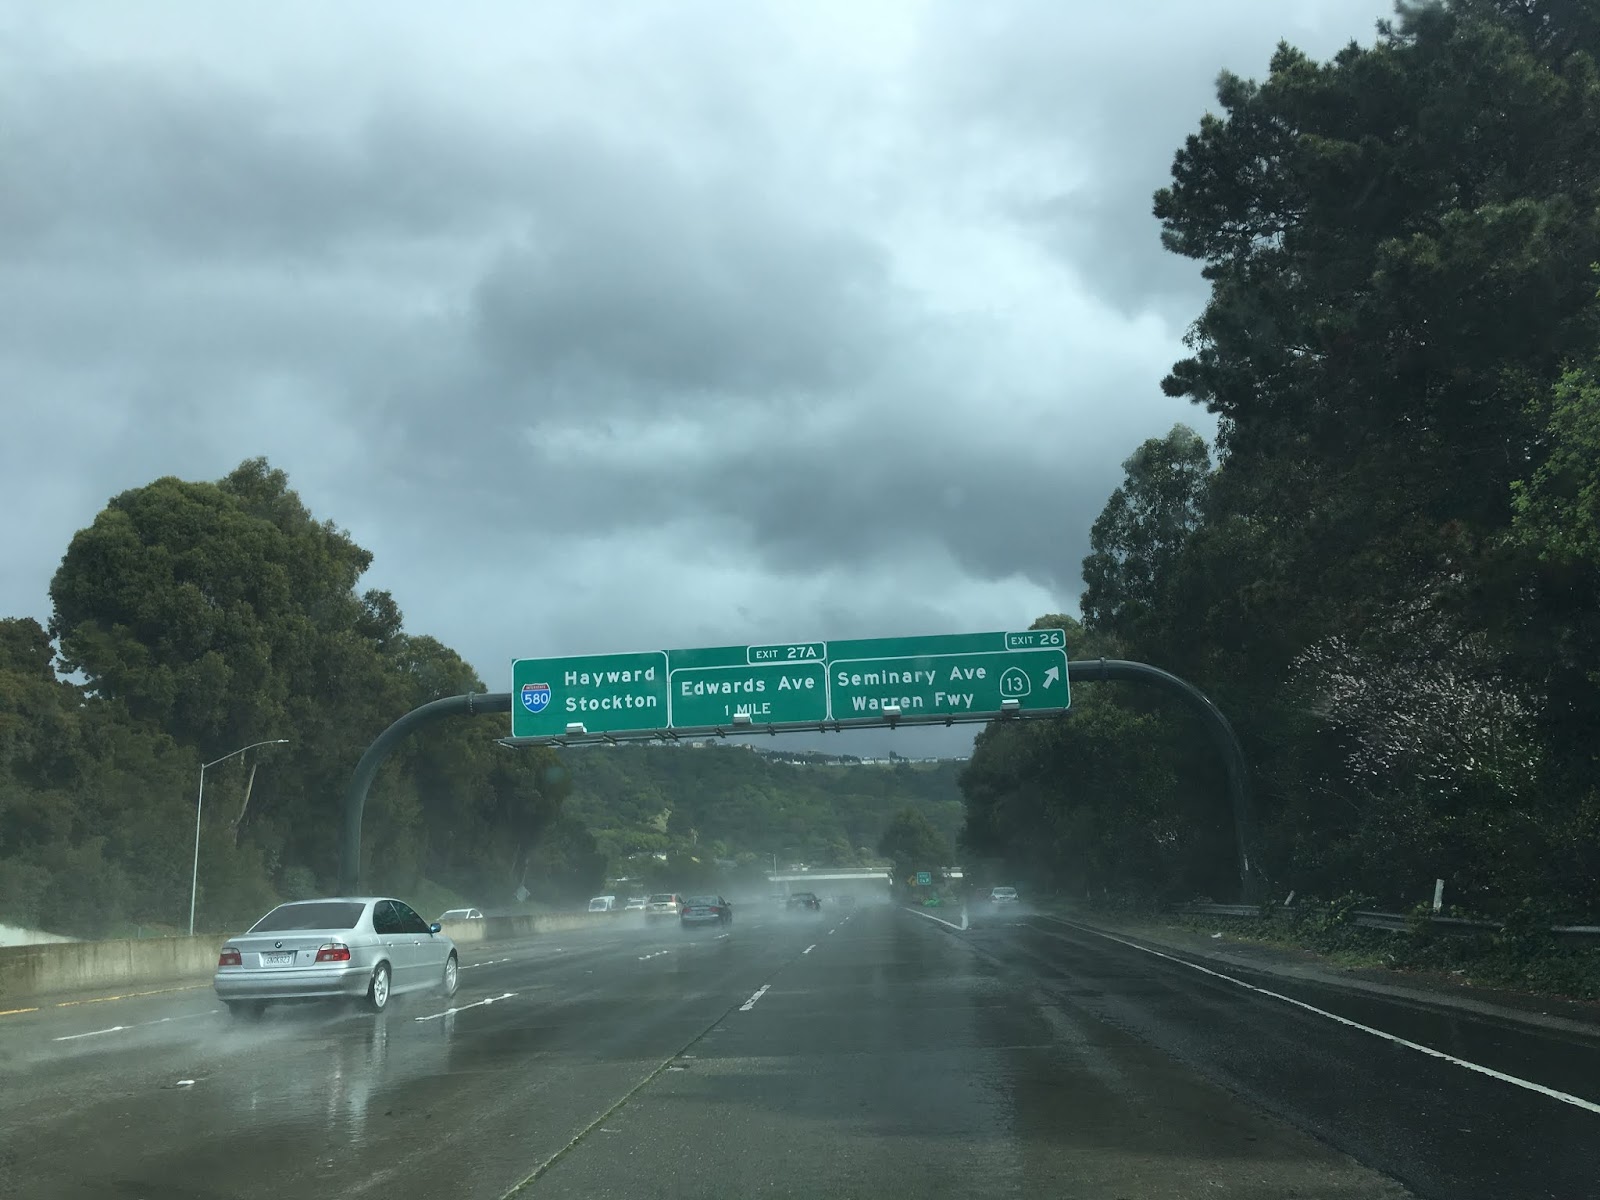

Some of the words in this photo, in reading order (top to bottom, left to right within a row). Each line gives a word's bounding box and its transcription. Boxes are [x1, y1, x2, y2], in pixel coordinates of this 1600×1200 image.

[1011, 636, 1033, 645] EXIT
[1040, 633, 1060, 645] 26
[756, 649, 778, 659] EXIT
[787, 646, 817, 659] 27A
[564, 666, 655, 687] Hayward
[837, 669, 936, 687] Seminary
[949, 666, 987, 680] Ave
[1007, 677, 1023, 692] 13
[681, 677, 766, 696] Edwards
[777, 675, 815, 691] Ave
[524, 692, 549, 705] 580
[565, 694, 657, 712] Stockton
[851, 695, 924, 711] Warren
[934, 691, 974, 709] Fwy
[724, 704, 729, 716] 1
[736, 702, 771, 716] MILE
